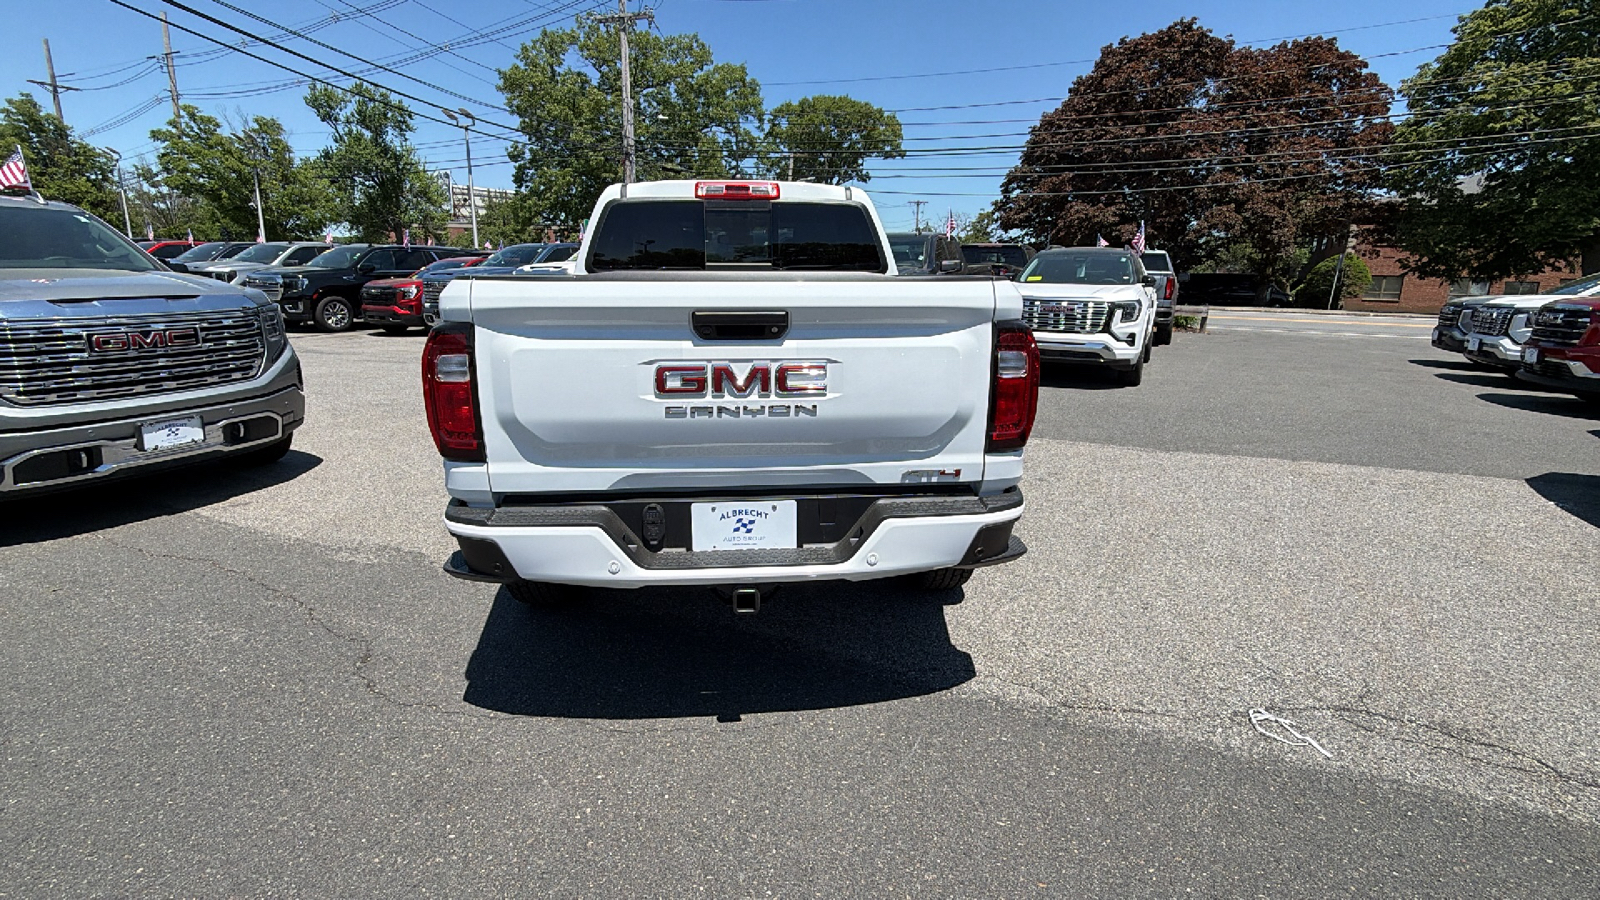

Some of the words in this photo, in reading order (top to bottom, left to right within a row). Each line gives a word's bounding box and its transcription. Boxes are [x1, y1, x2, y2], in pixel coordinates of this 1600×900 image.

[93, 328, 197, 351] GMC
[653, 361, 827, 399] GMC
[664, 404, 817, 419] CANYON
[719, 509, 769, 521] ALBRECHT
